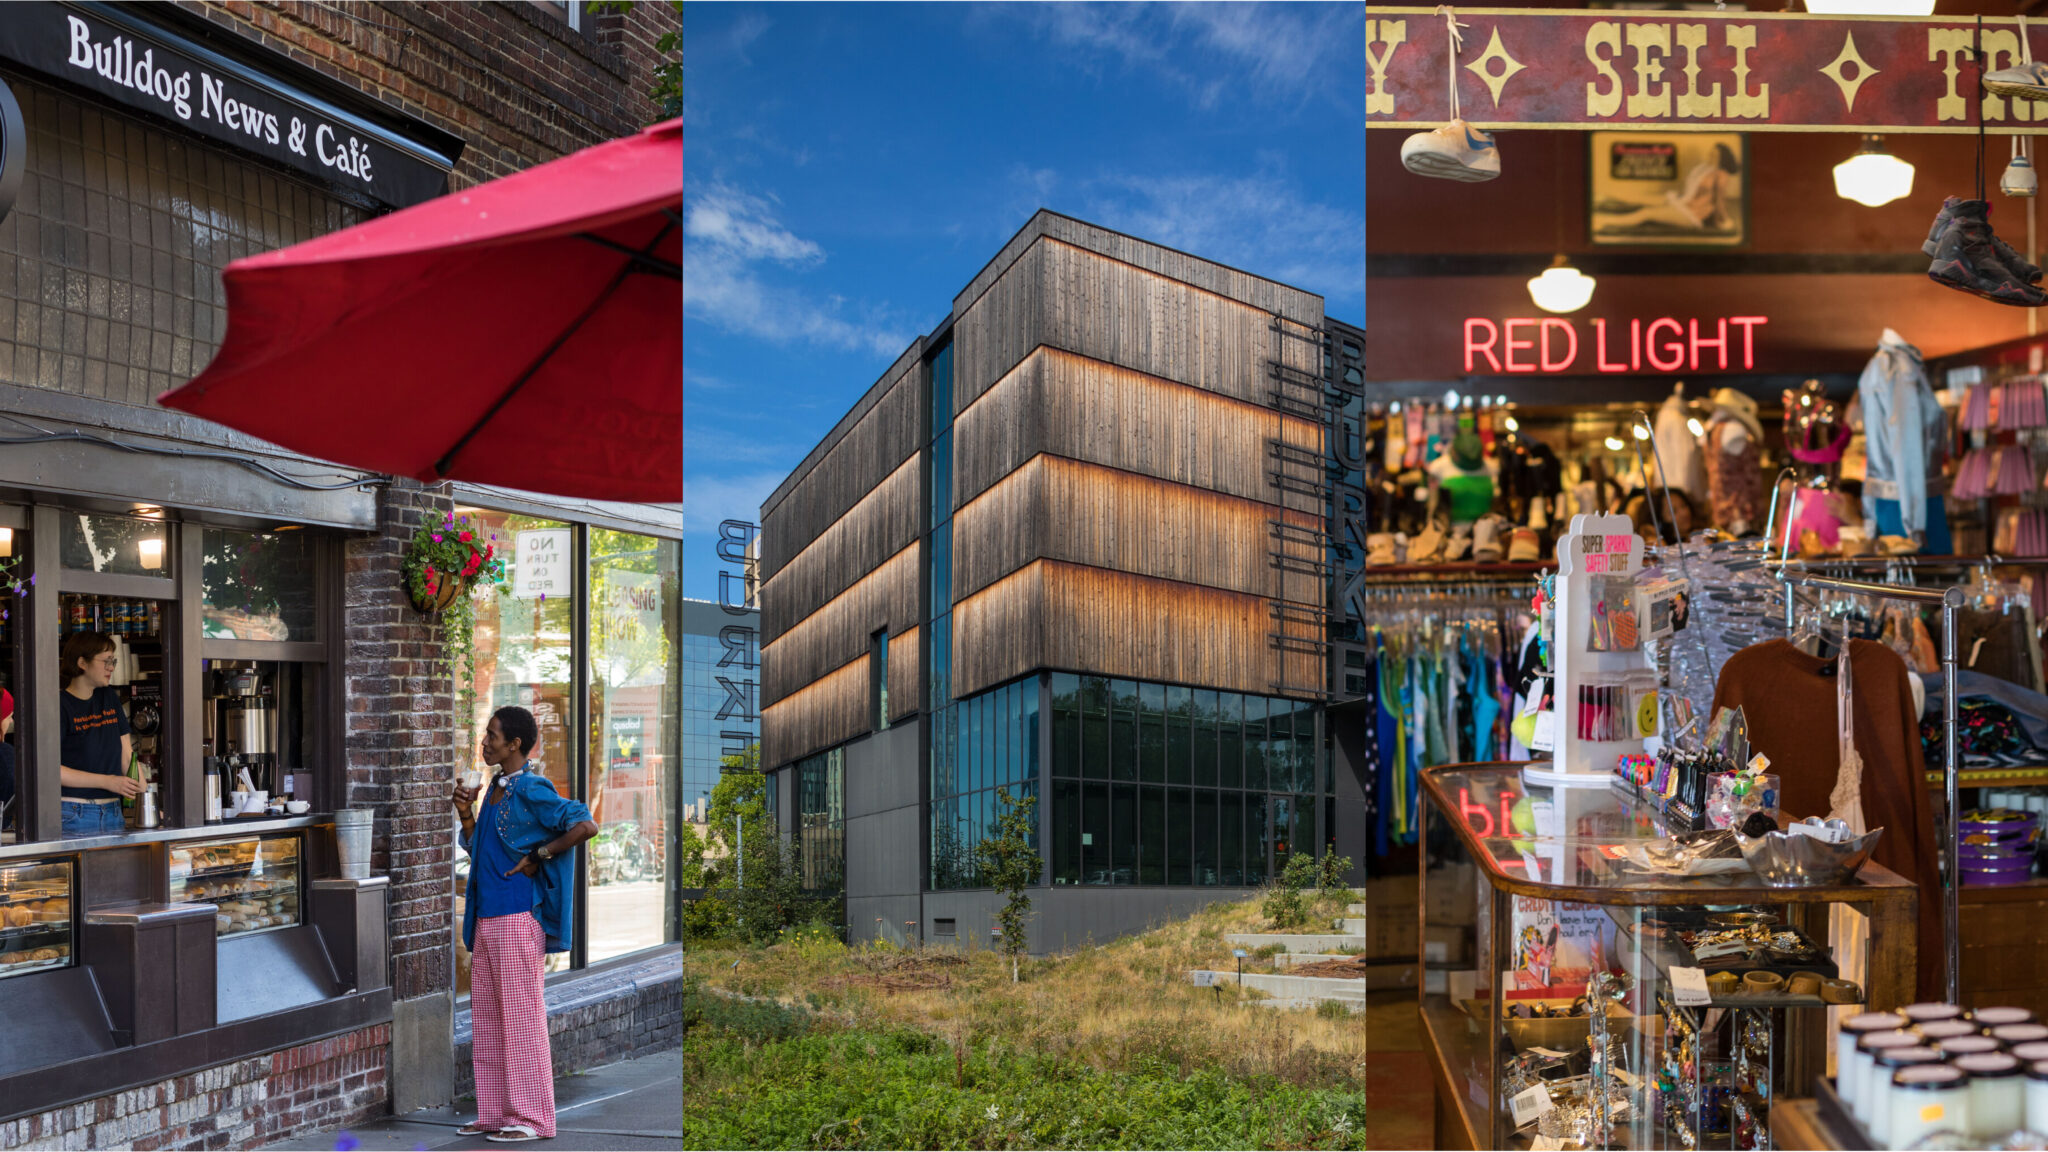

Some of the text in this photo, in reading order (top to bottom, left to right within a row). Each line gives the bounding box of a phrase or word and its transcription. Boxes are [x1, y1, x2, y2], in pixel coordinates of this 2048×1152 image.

[67, 15, 373, 182] Bulldog News & Café
[1585, 21, 1769, 118] SELL
[1928, 28, 2048, 121] TR
[1464, 316, 1768, 373] RED LIGHT
[1585, 553, 1629, 573] SAFETY STUFF
[607, 583, 656, 611] LEASING
